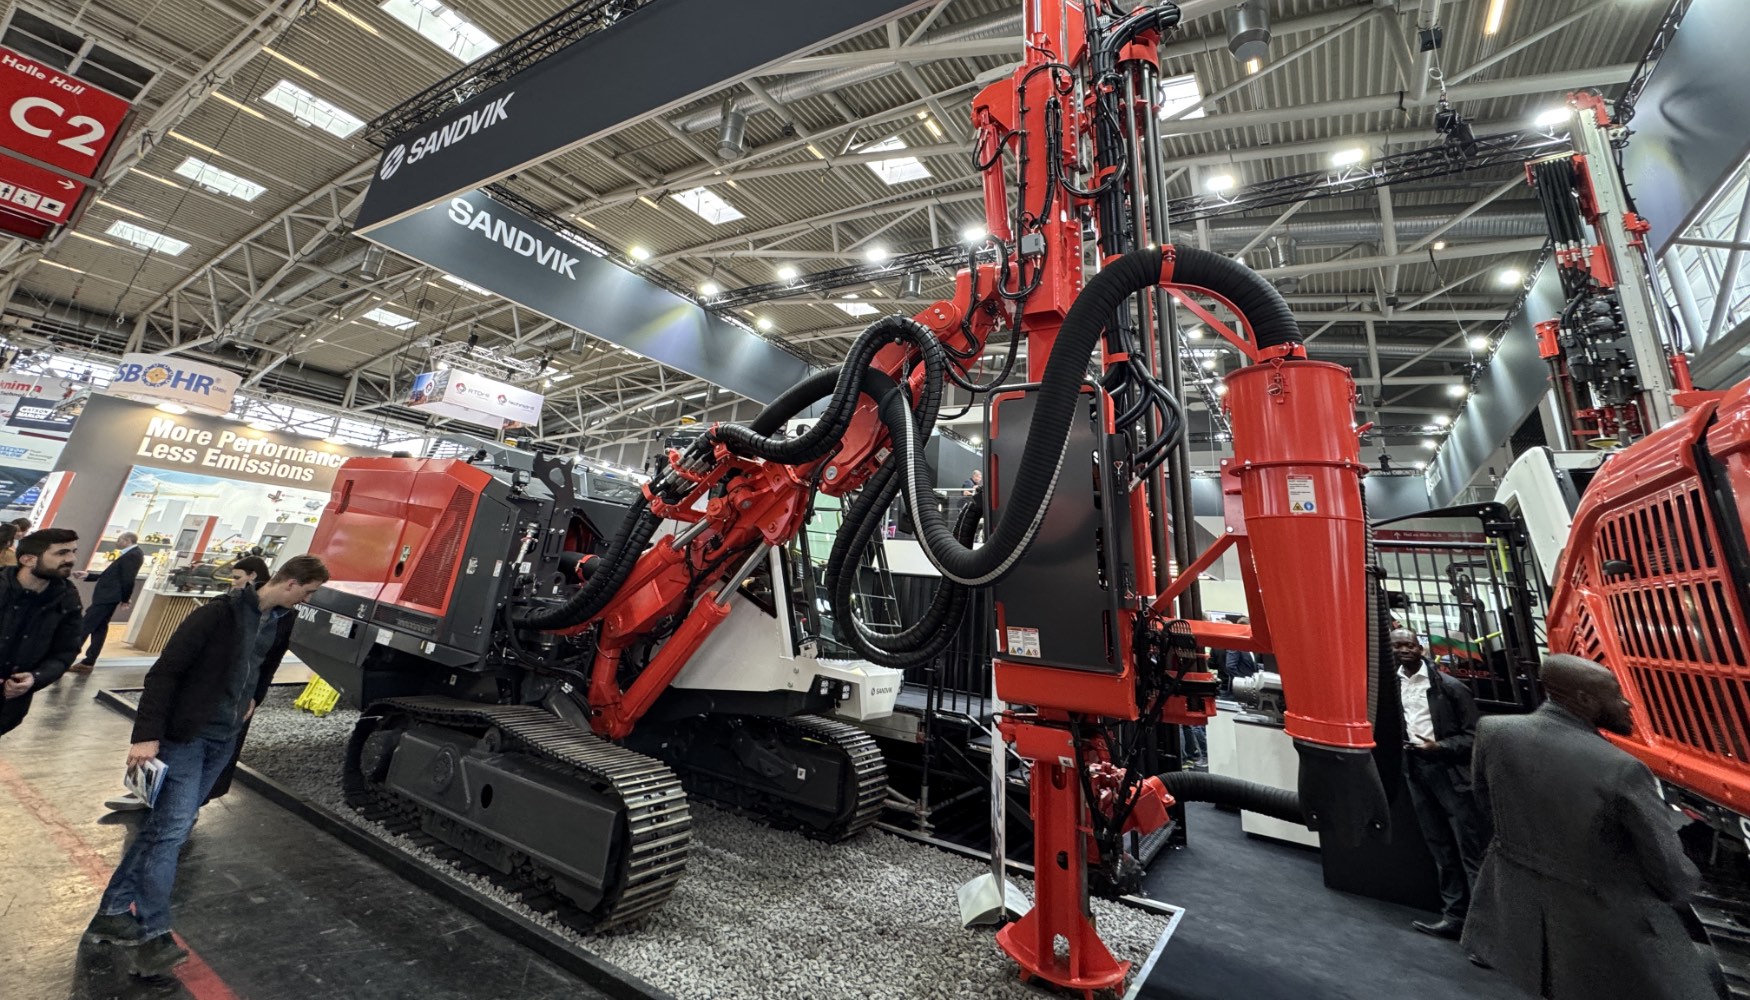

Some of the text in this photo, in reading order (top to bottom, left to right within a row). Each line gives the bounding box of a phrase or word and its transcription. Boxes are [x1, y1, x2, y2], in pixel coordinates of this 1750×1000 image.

[1, 54, 86, 96] Halle Hall
[10, 96, 105, 157] C2
[407, 91, 515, 165] SANDVIK
[448, 197, 580, 281] SANDVIK
[145, 416, 213, 446] More
[136, 436, 315, 482] Less Emissions
[292, 603, 319, 622] NDVIK
[876, 687, 893, 695] SANDVIK
